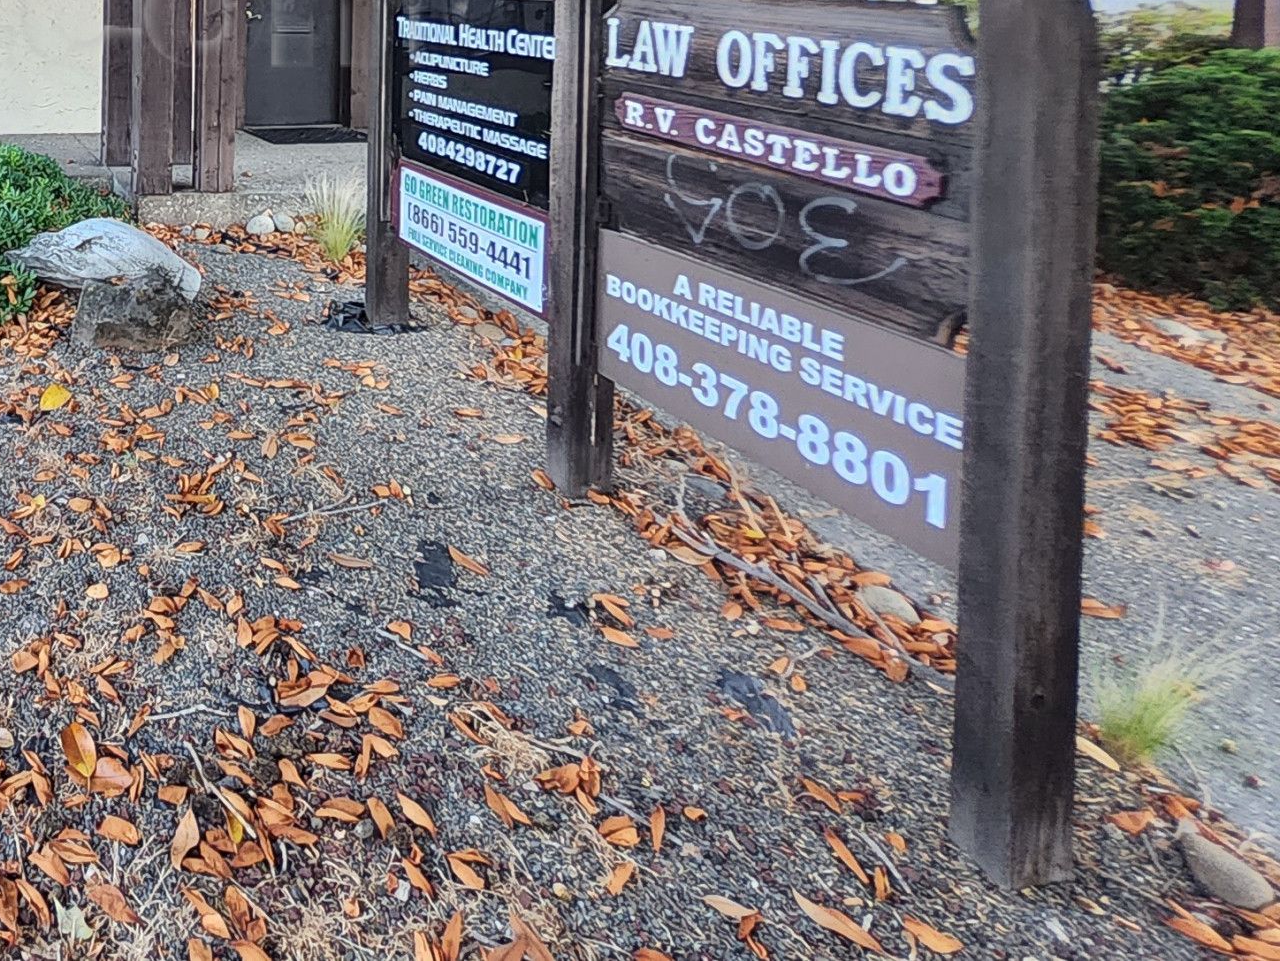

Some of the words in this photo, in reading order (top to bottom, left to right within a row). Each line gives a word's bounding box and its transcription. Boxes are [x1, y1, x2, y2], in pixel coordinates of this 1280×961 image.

[396, 16, 458, 46] TRADITIONAL
[459, 23, 505, 53] HEALTH
[506, 29, 556, 60] CENTE
[414, 51, 489, 76] ACUPUNCTURE
[605, 17, 695, 78] LAW
[716, 30, 975, 125] OFFICES
[413, 89, 436, 107] PAIN
[438, 97, 518, 127] MANAGEMENT
[414, 70, 448, 89] HERBS
[413, 108, 481, 140] THERAPEUTIC
[483, 128, 547, 159] MASSAGE
[418, 132, 521, 184] 4084298727
[623, 99, 678, 136] R.V.
[694, 117, 918, 196] CASTELLO
[404, 173, 418, 196] GO
[420, 178, 449, 212] GREEN
[452, 191, 539, 249] RESTORATION
[408, 201, 444, 237] (866)
[448, 222, 531, 280] 559-4441
[407, 226, 421, 244] FULL
[422, 232, 448, 258] SERVICE
[449, 250, 484, 278] CLEANING
[485, 267, 529, 300] COMPANY
[673, 274, 693, 300] A
[698, 282, 845, 362] RELIABLE
[605, 274, 793, 372] BOOKKEEPING
[799, 357, 964, 450] SERVICE
[606, 324, 947, 529] 408-378-8801
